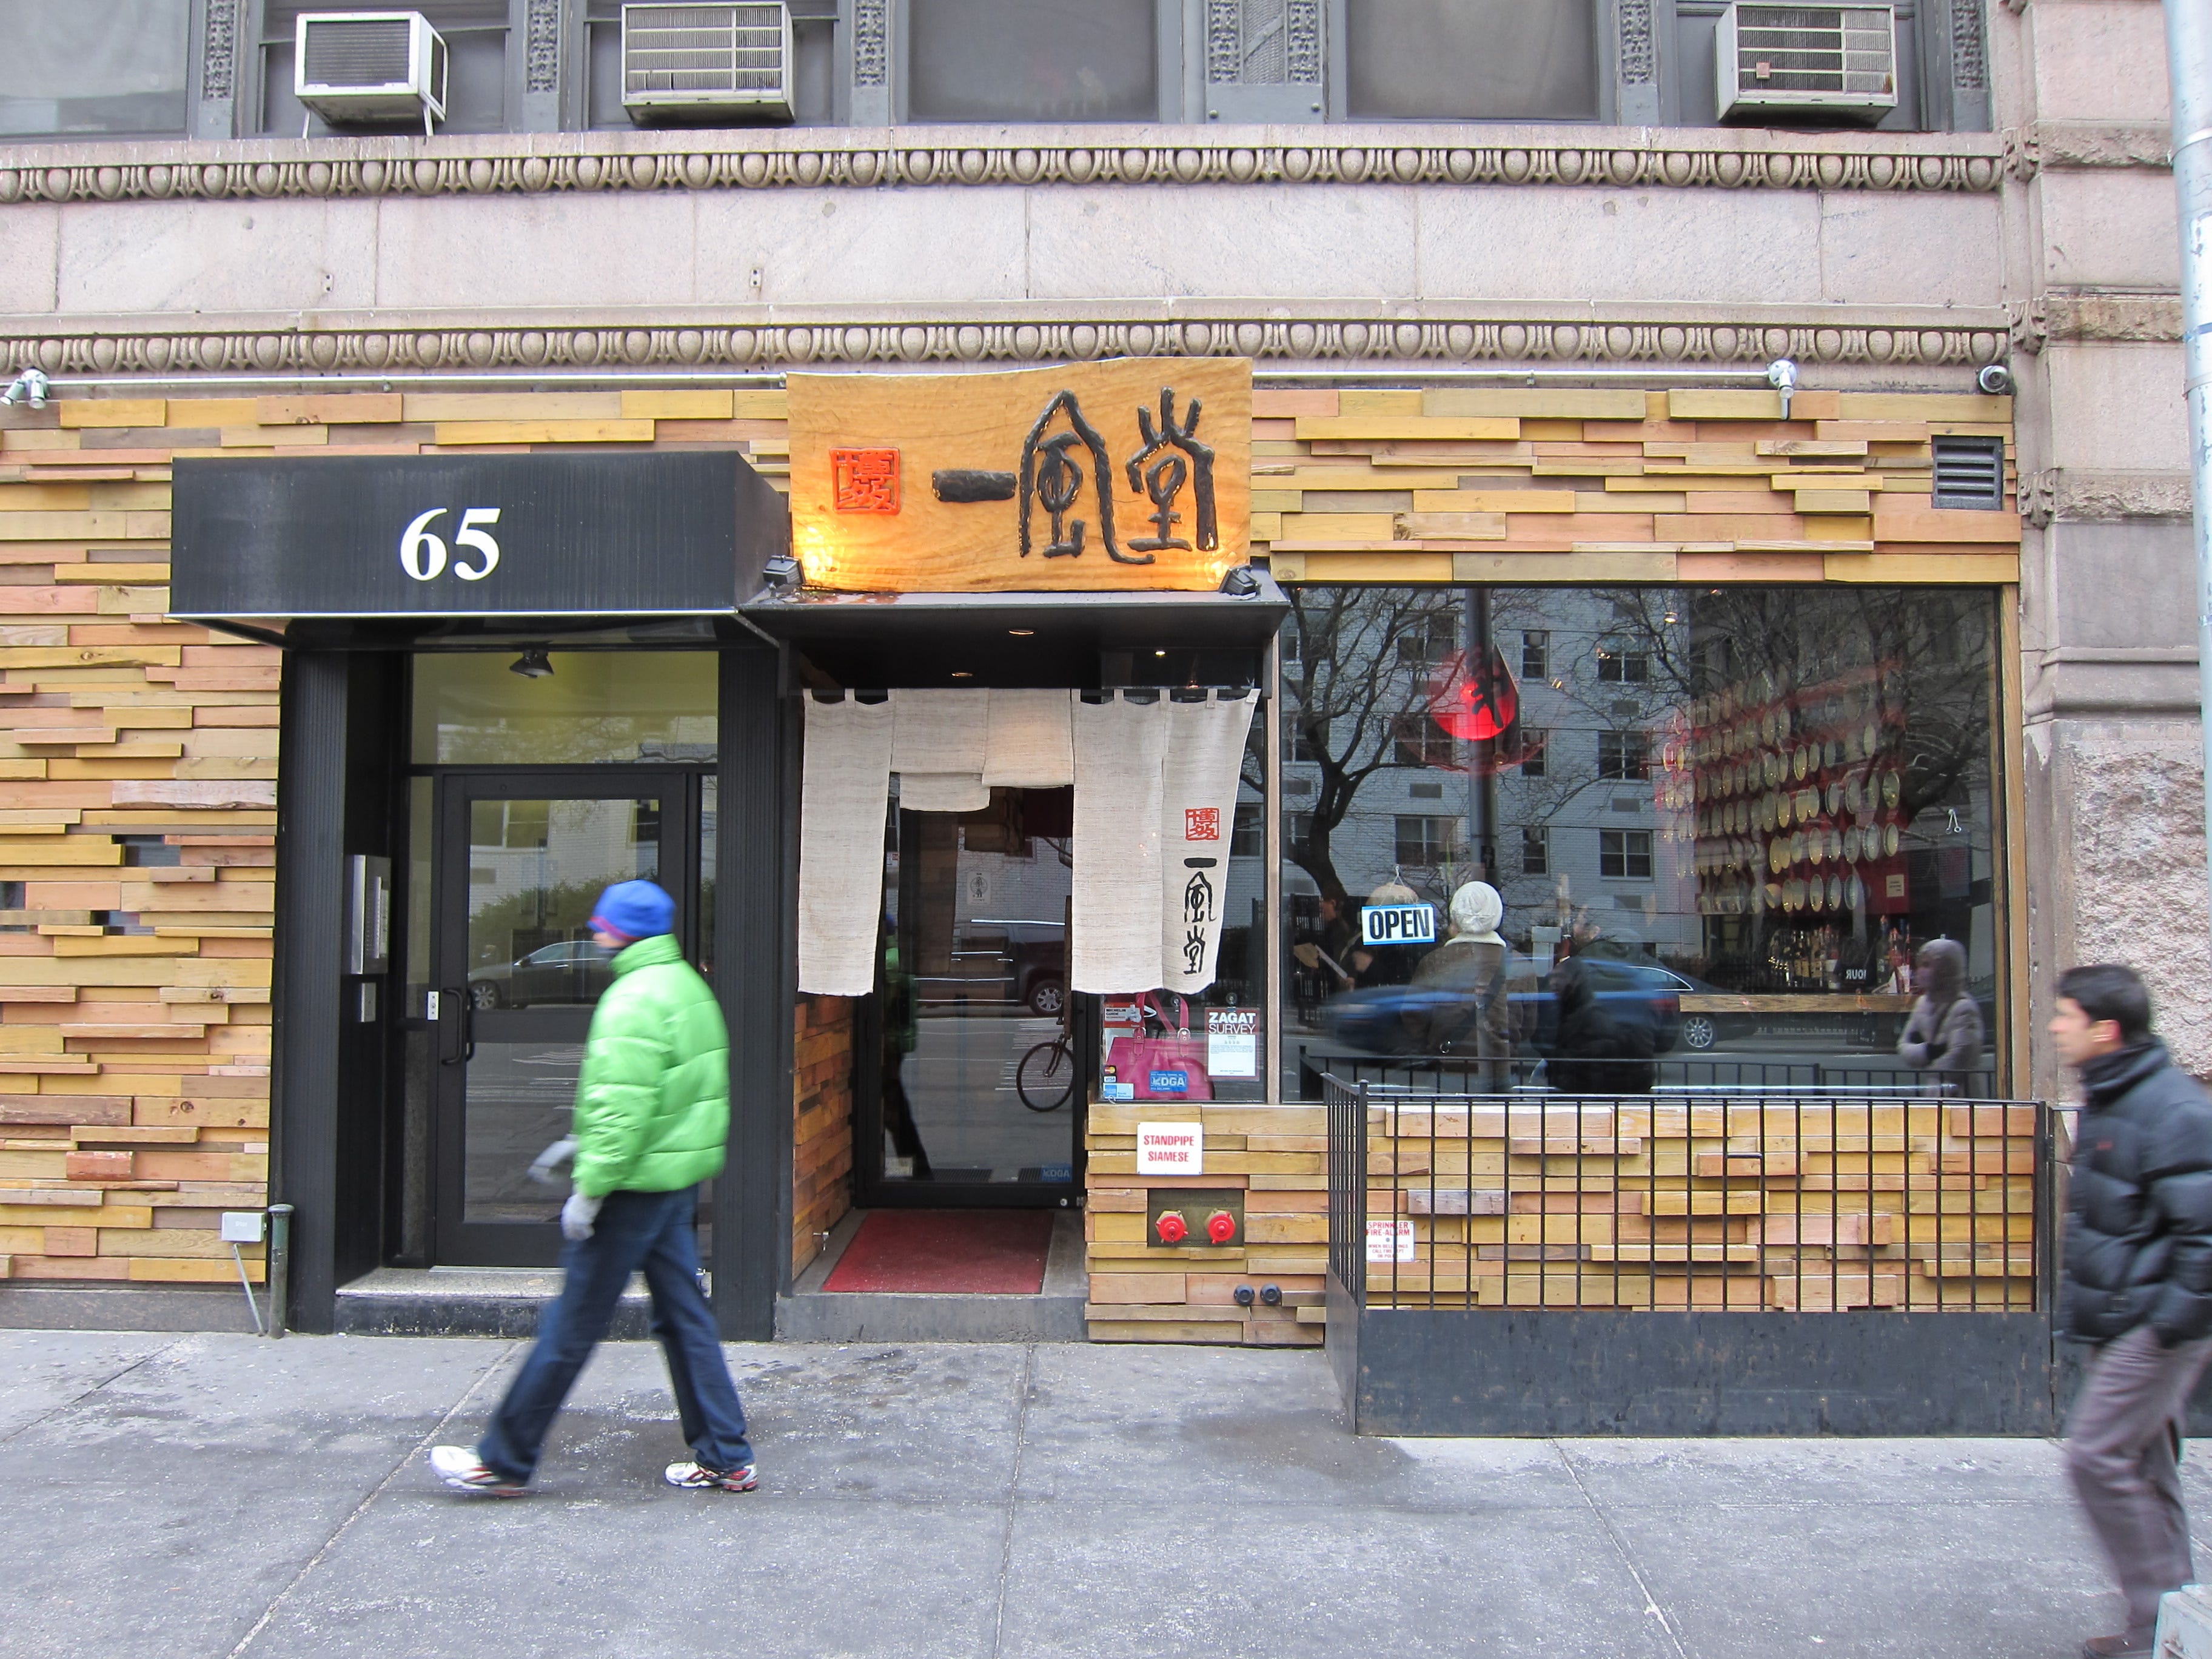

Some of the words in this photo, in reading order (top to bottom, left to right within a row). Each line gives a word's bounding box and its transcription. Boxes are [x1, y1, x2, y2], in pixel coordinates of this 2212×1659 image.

[399, 506, 501, 581] 65
[1369, 909, 1430, 940] OPEN
[1208, 1012, 1256, 1024] ZAGAT
[1208, 1024, 1256, 1034] SURVEY
[1144, 1135, 1195, 1146] STANDPIPE
[1148, 1151, 1189, 1162] SIAMESE
